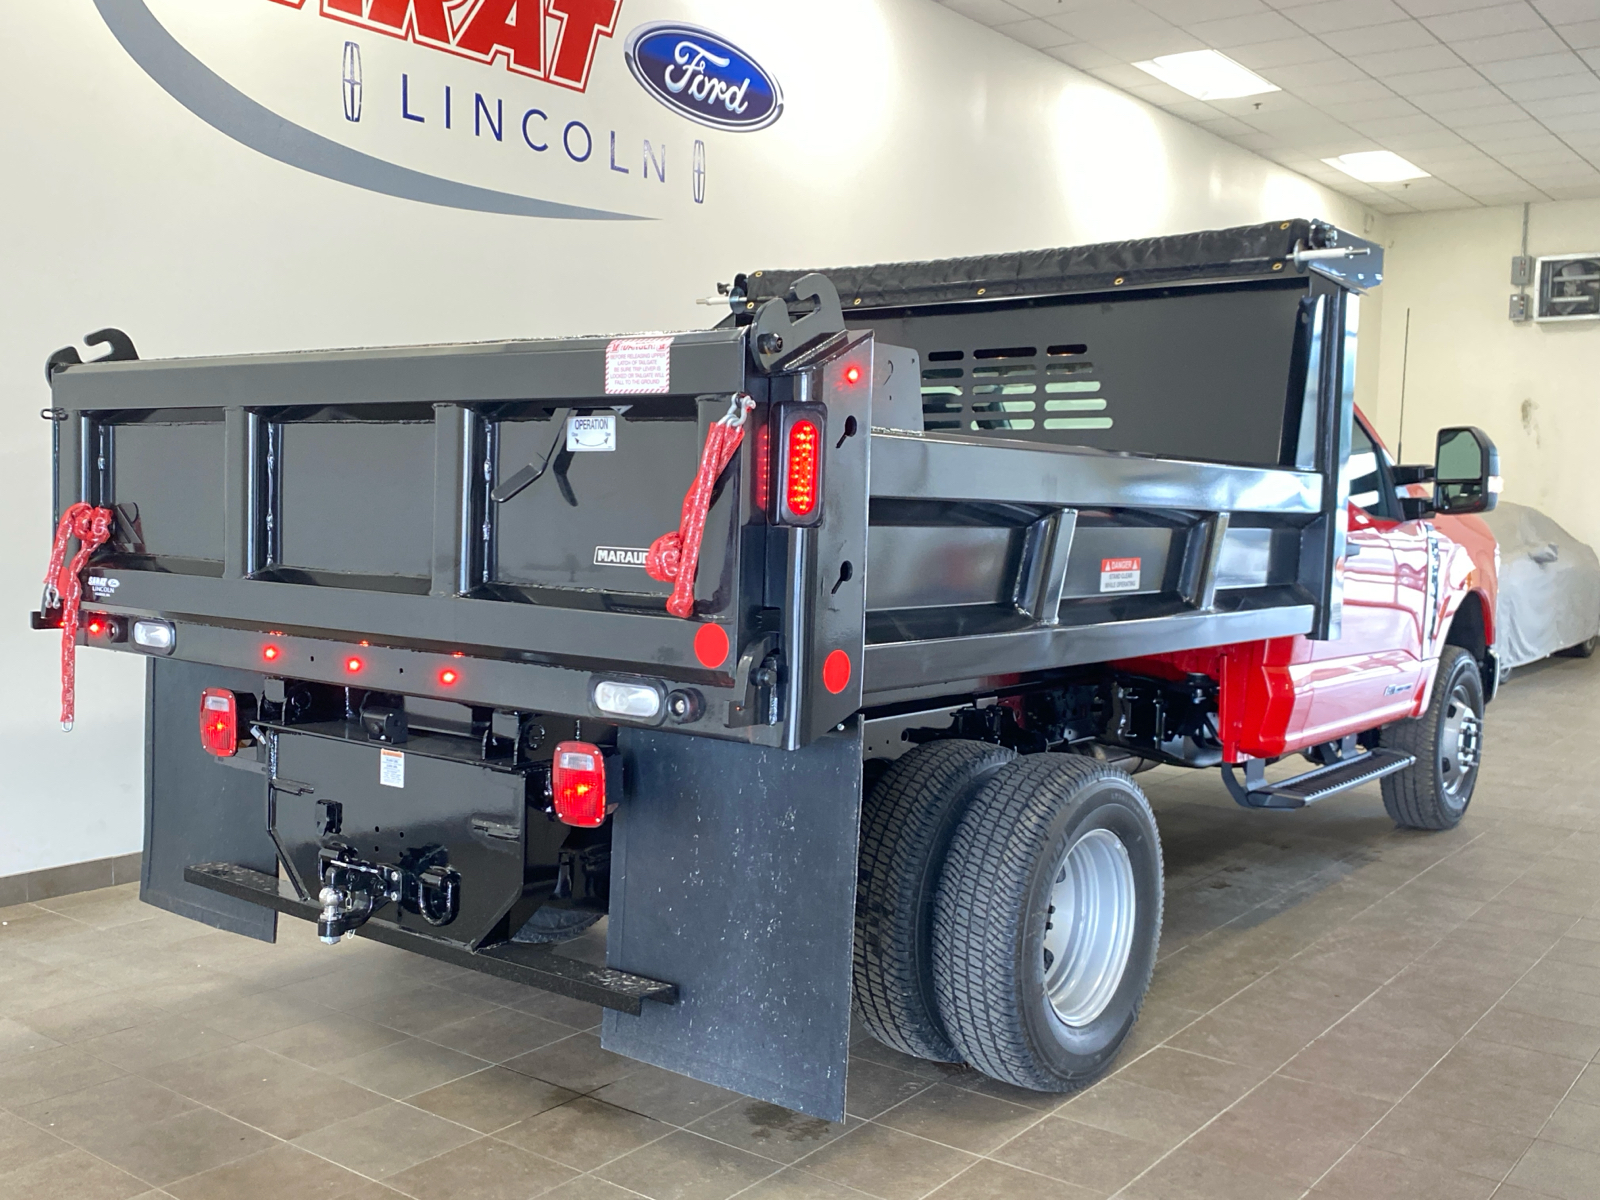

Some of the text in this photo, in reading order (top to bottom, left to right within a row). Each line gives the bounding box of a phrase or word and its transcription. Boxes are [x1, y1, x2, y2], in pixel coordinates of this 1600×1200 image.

[664, 40, 751, 114] Ford
[402, 73, 666, 183] LINCOLN
[574, 418, 608, 430] OPERATION
